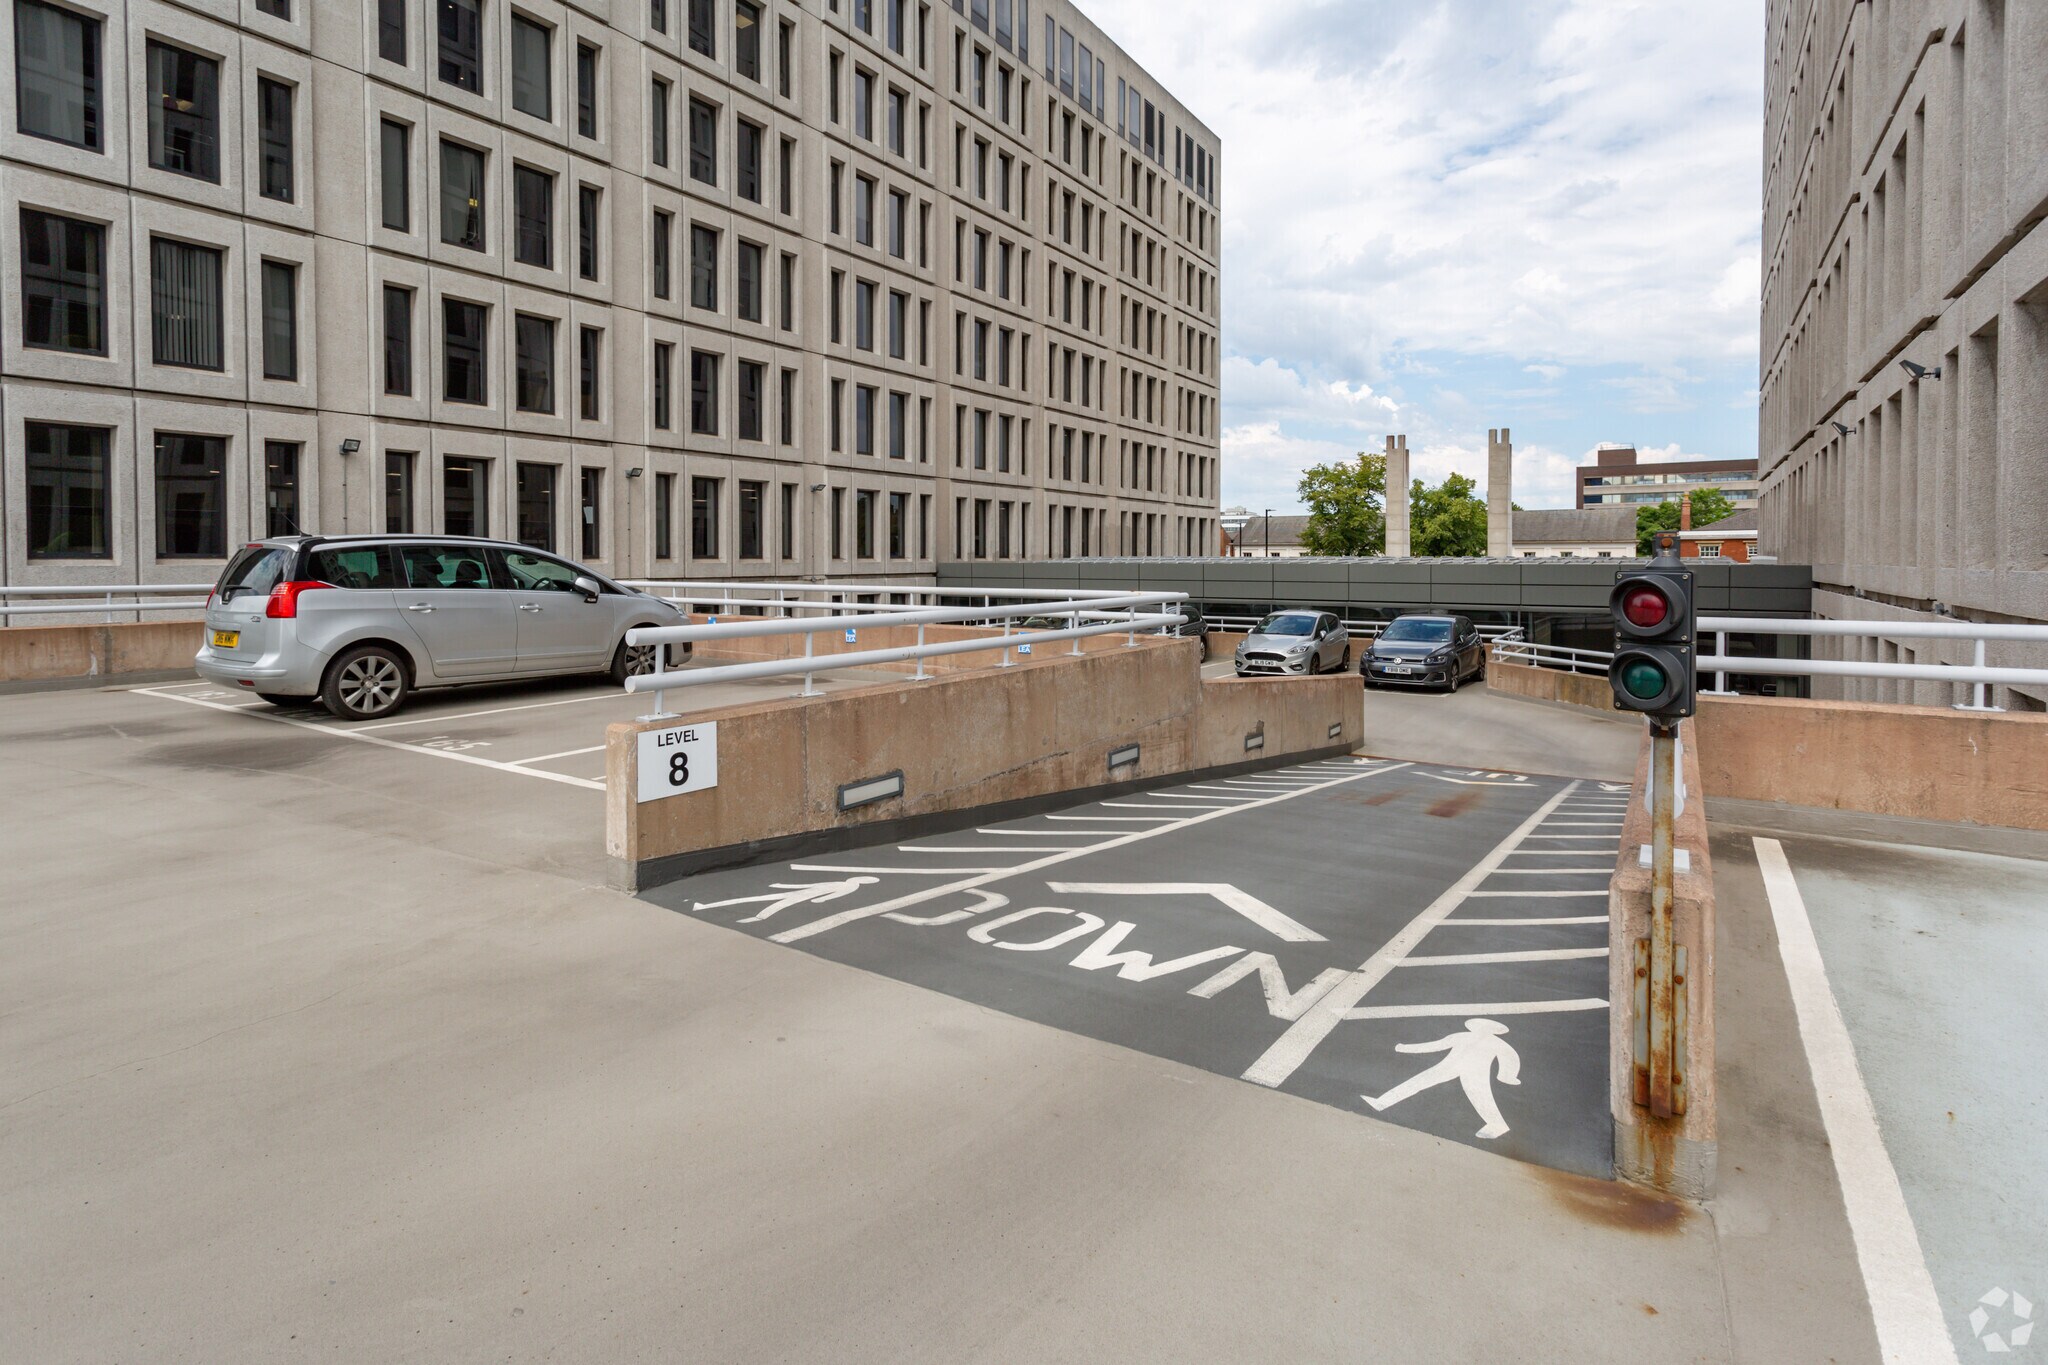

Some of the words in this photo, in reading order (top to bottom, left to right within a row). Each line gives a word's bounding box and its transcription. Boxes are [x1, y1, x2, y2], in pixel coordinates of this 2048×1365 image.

[658, 729, 699, 747] LEVEL
[669, 751, 690, 787] 8
[880, 888, 1354, 1022] DOWN
